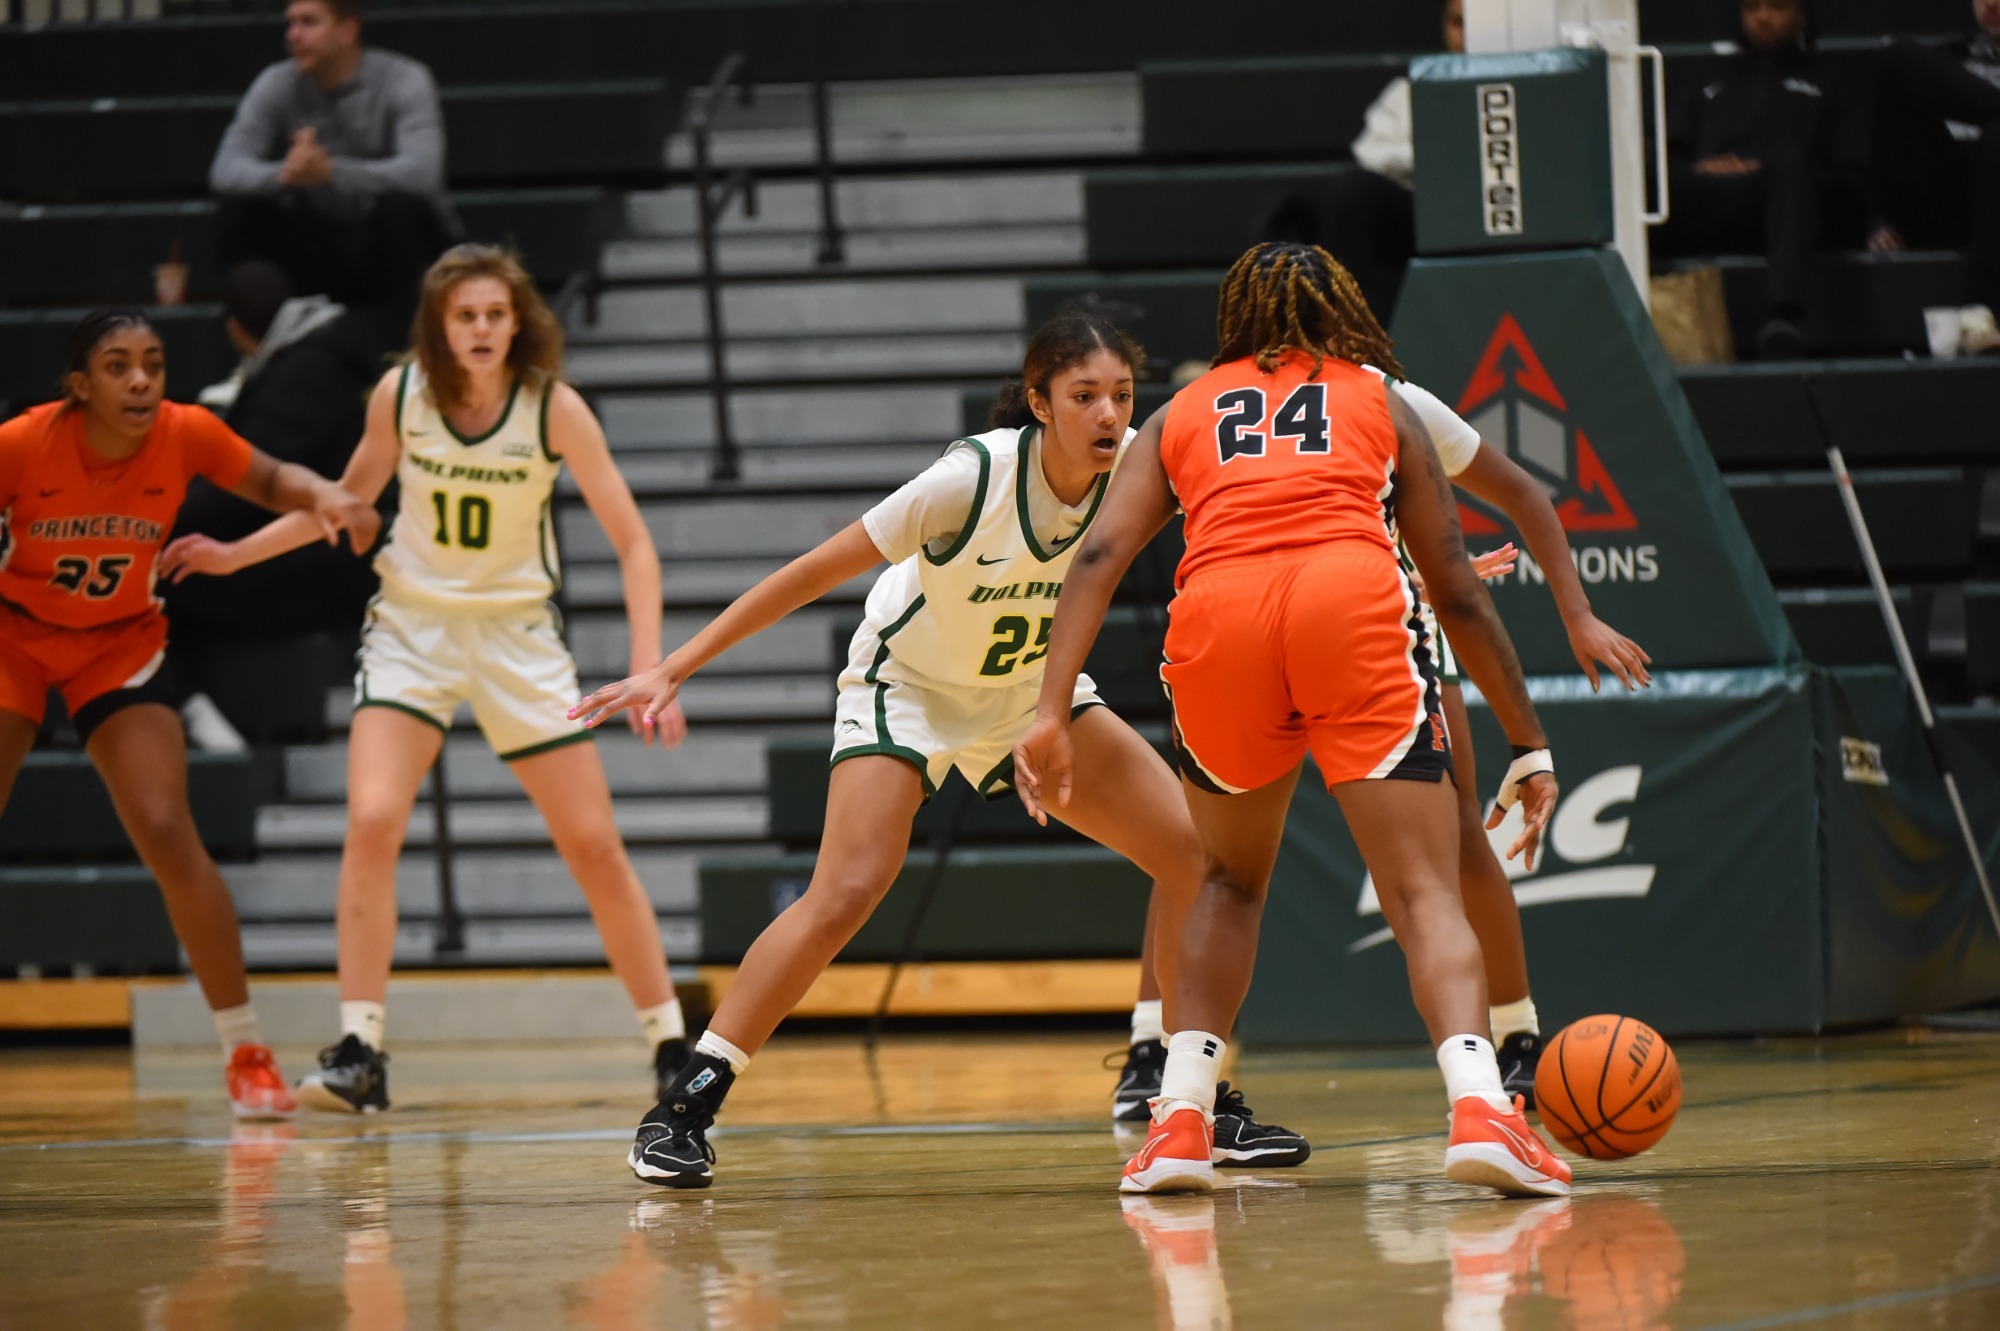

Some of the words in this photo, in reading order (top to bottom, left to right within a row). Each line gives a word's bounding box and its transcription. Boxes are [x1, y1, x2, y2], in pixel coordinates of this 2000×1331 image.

[1214, 382, 1331, 466] 24
[28, 515, 162, 544] PRINCETON
[431, 489, 492, 550] 10
[50, 554, 134, 600] 25
[966, 581, 1063, 605] DOLPH
